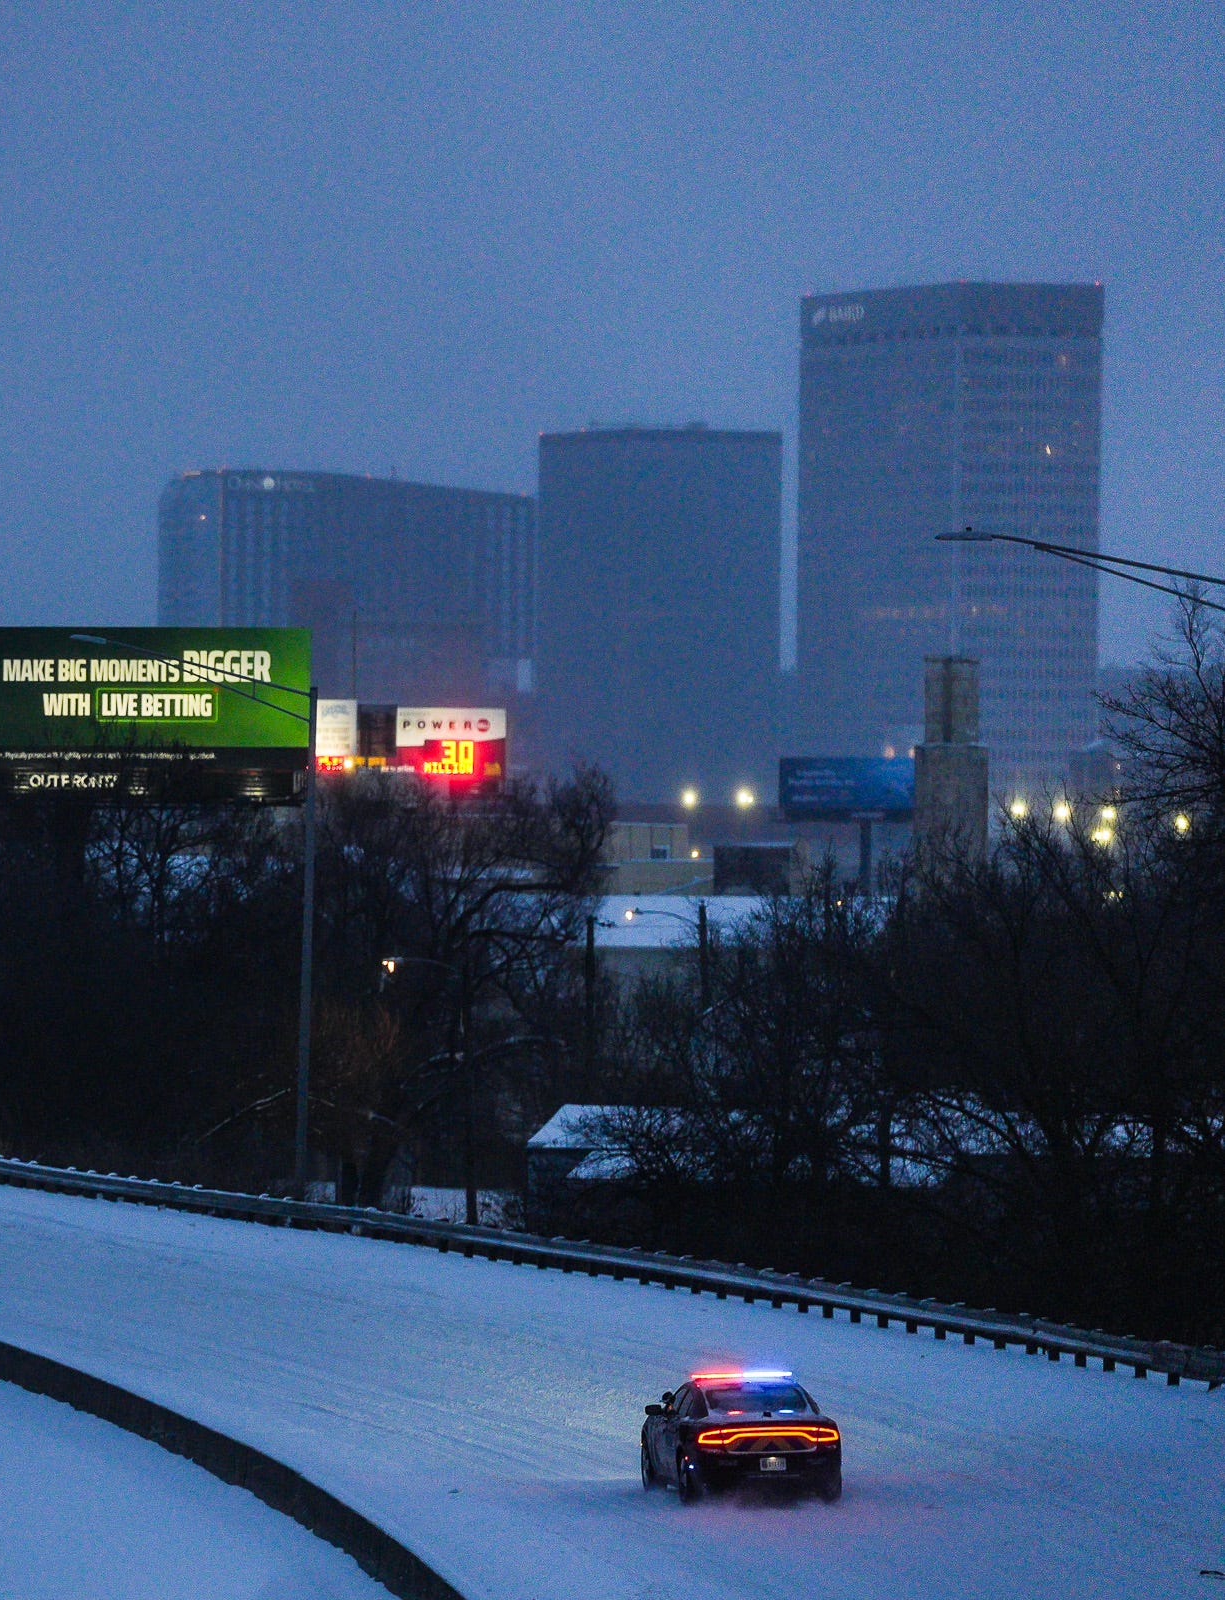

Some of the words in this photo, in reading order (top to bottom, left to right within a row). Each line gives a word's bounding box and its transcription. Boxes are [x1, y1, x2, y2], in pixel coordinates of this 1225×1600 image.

[3, 659, 54, 682] MAKE
[57, 659, 86, 682] BIG
[90, 659, 179, 682] MOMENTS
[183, 650, 271, 682] BIGGER
[43, 693, 90, 716] WITH
[101, 693, 138, 716] LIVE
[141, 693, 212, 716] BETTING
[403, 720, 472, 730] POWER
[441, 740, 474, 764] 30
[424, 762, 473, 774] MILLION
